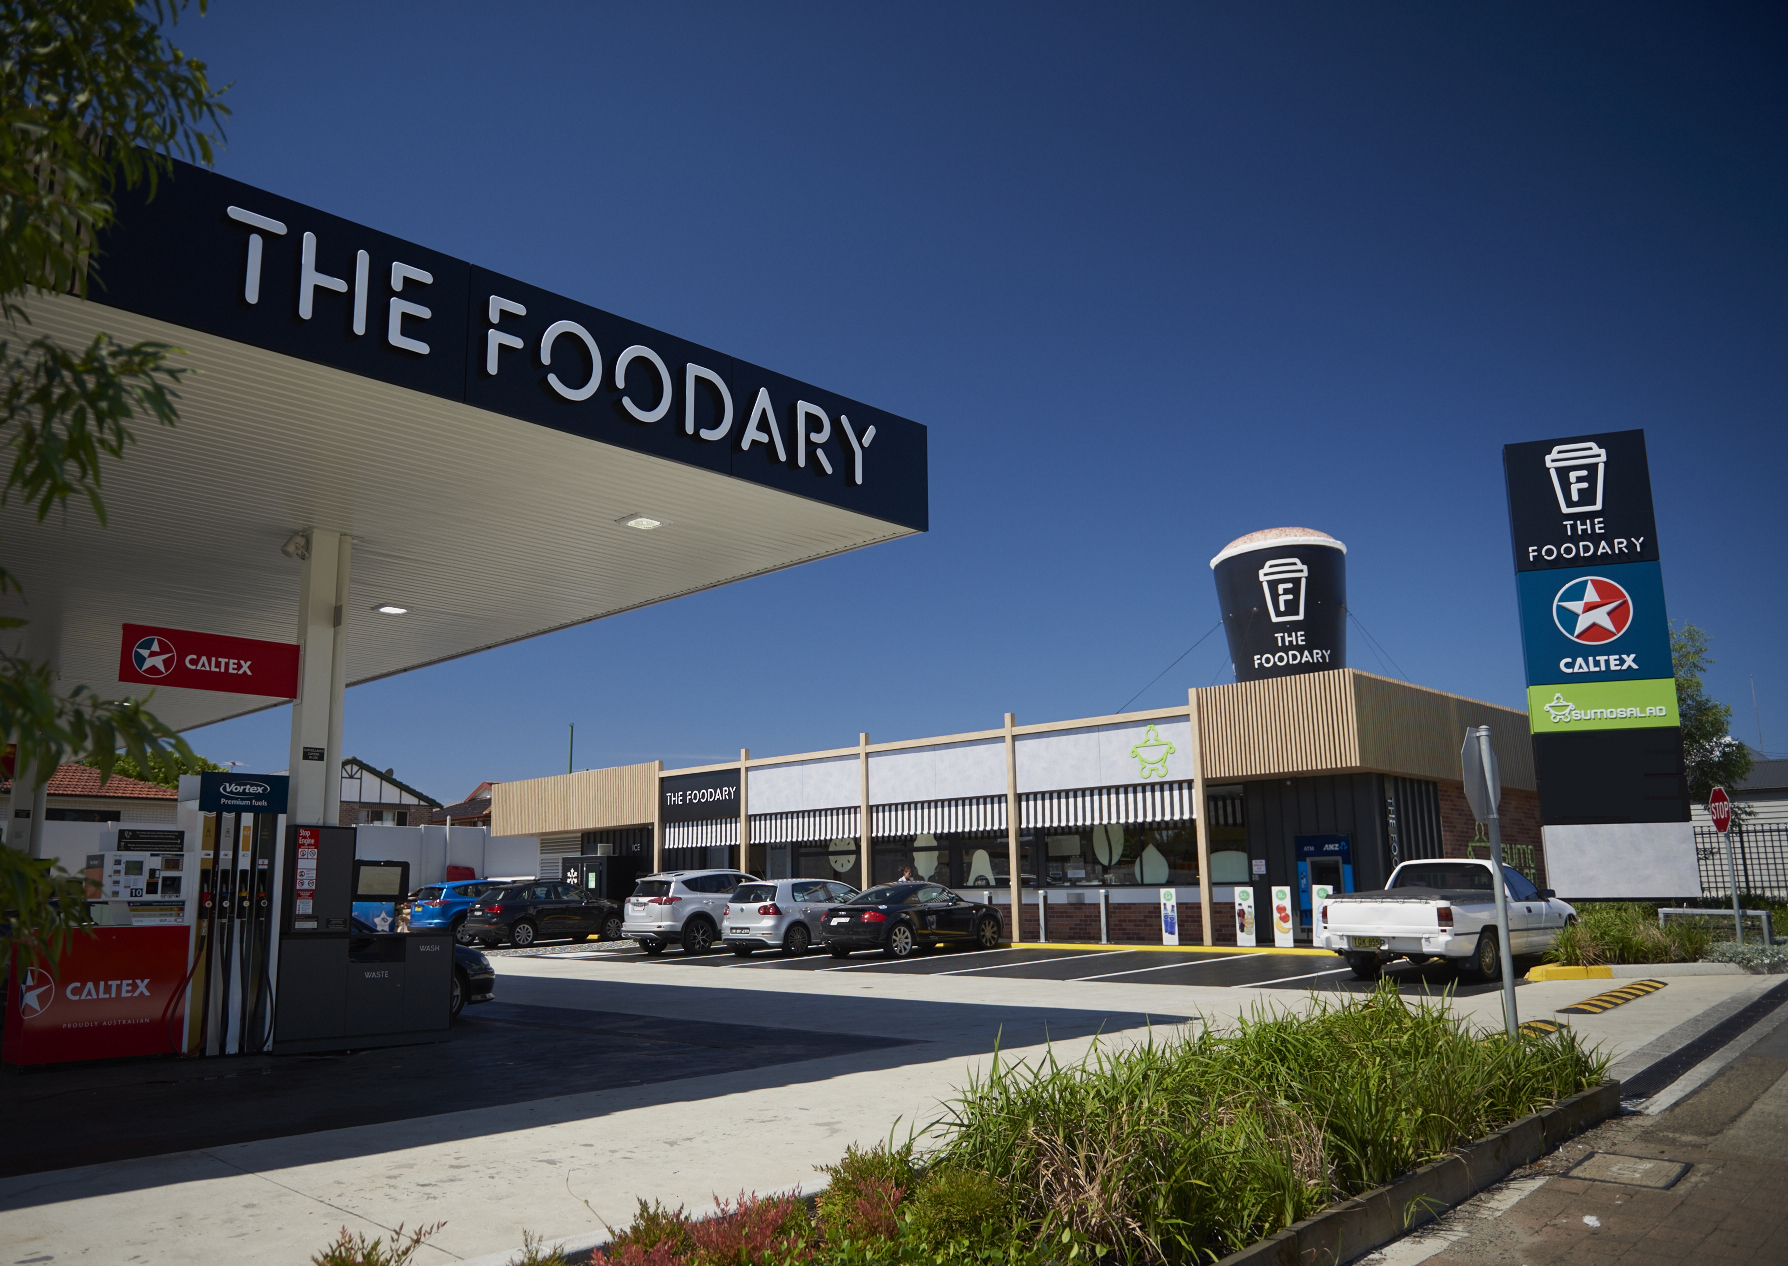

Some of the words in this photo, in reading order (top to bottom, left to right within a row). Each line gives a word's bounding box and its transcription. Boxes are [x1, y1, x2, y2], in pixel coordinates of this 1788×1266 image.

[226, 205, 434, 355] THE
[486, 294, 877, 485] FOODARY
[1569, 470, 1589, 502] F
[1563, 518, 1605, 536] THE
[1528, 536, 1645, 562] FOODARY
[1277, 583, 1294, 612] F
[1274, 631, 1306, 647] THE
[185, 654, 253, 676] CALTEX
[1253, 649, 1331, 669] FOODARY
[1559, 654, 1639, 674] CALTEX
[1572, 706, 1667, 721] SUMOSALAD
[222, 782, 265, 794] Vortex
[665, 792, 683, 806] THE
[686, 786, 737, 804] FOODARY
[221, 798, 251, 806] Premium
[252, 799, 268, 807] fuels
[1711, 801, 1729, 820] STOP
[1387, 796, 1397, 828] THE
[299, 829, 311, 838] Stop
[299, 837, 315, 846] Engine
[631, 843, 640, 852] ICE
[1322, 843, 1340, 851] ANZ
[131, 889, 143, 897] 10
[419, 944, 440, 952] WASH
[364, 970, 389, 979] WASTE
[65, 978, 151, 1001] CALTEX
[62, 1021, 99, 1029] PROUDLY
[102, 1018, 150, 1026] AUSTRALIAN
